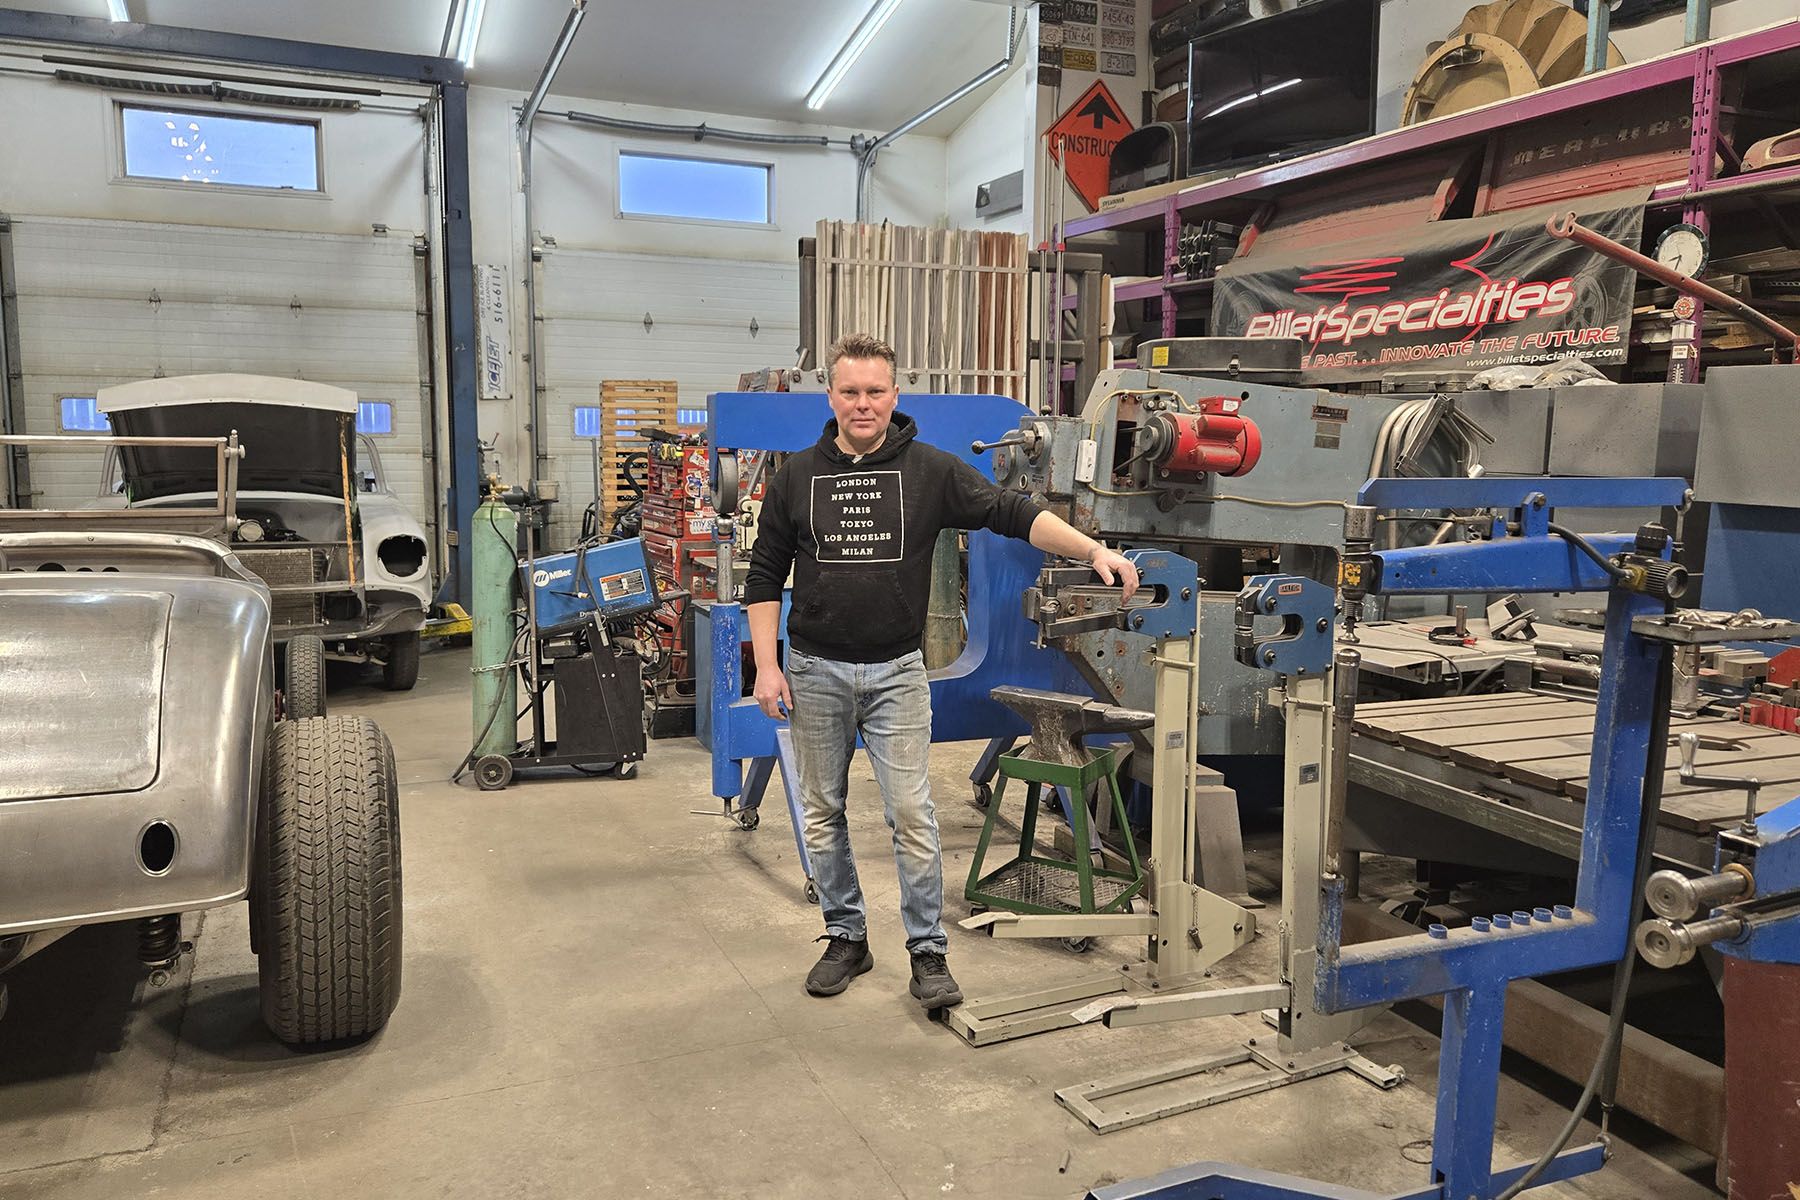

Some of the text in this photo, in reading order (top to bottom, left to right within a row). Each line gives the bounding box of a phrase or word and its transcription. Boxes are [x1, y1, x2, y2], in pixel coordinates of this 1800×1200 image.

[1051, 132, 1118, 158] CONSTRUC
[492, 267, 503, 323] 516-6111
[1379, 341, 1475, 363] INNOVATE
[1480, 336, 1518, 354] THE
[1521, 326, 1620, 350] FUTURE.
[1466, 348, 1624, 367] www.billetspecialties.com
[836, 478, 877, 488] LONDON
[831, 491, 882, 501] NEW YORK
[842, 506, 871, 514] PARIS
[840, 520, 874, 528] TOKYO
[824, 532, 892, 542] LOS ANGELES
[841, 547, 874, 556] MILAN
[549, 569, 572, 580] Miller
